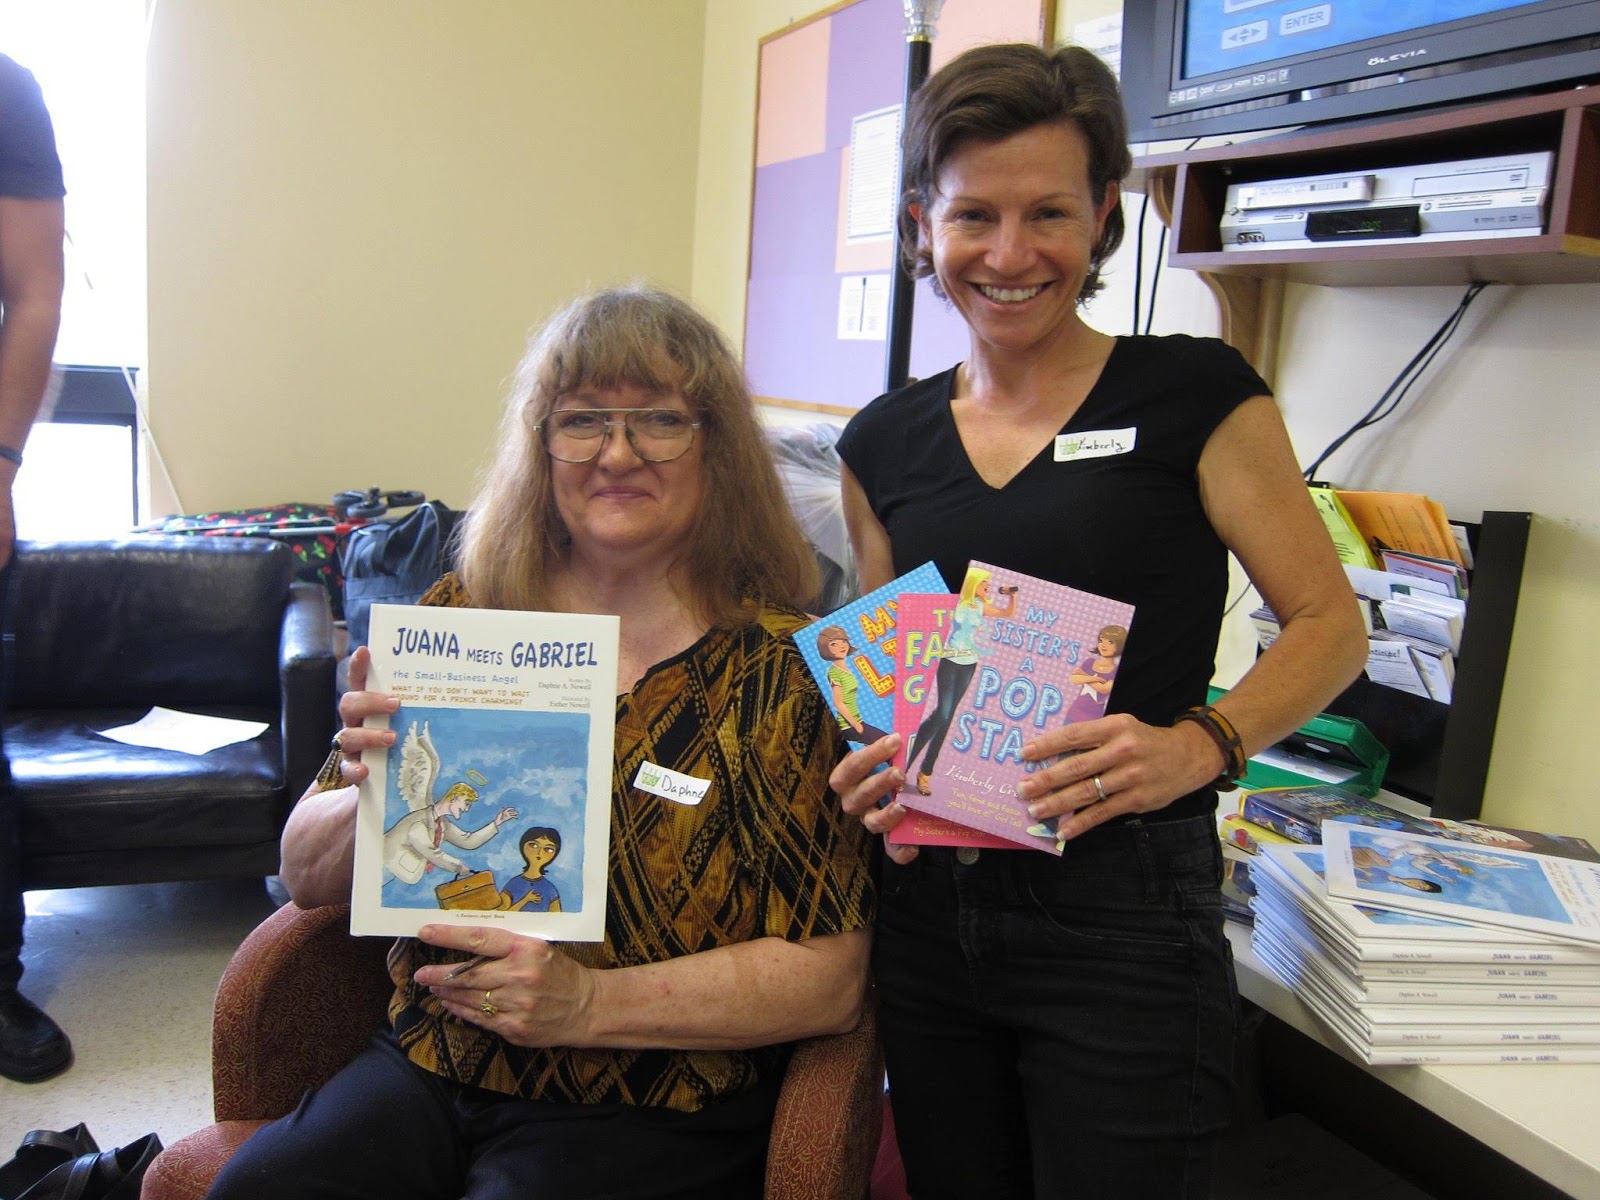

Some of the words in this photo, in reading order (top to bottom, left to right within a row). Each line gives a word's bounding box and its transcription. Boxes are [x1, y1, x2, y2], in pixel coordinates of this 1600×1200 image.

[1285, 11, 1324, 29] ENTER
[1077, 437, 1127, 453] Kimberly
[1025, 604, 1059, 628] MY
[392, 627, 460, 660] JUANA
[466, 648, 503, 665] MEETS
[511, 641, 597, 669] GABRIEL
[904, 631, 944, 669] FA
[991, 619, 1080, 665] SISTER'S
[1019, 656, 1035, 672] A
[393, 670, 409, 679] the
[415, 671, 486, 682] Small-Business
[492, 674, 519, 685] Angel
[903, 675, 926, 704] G
[446, 687, 468, 695] DON'T
[472, 688, 493, 696] WANT
[498, 689, 507, 697] TO
[973, 665, 1064, 729] POP
[661, 774, 704, 799] Daphne
[945, 765, 995, 795] Kimberly
